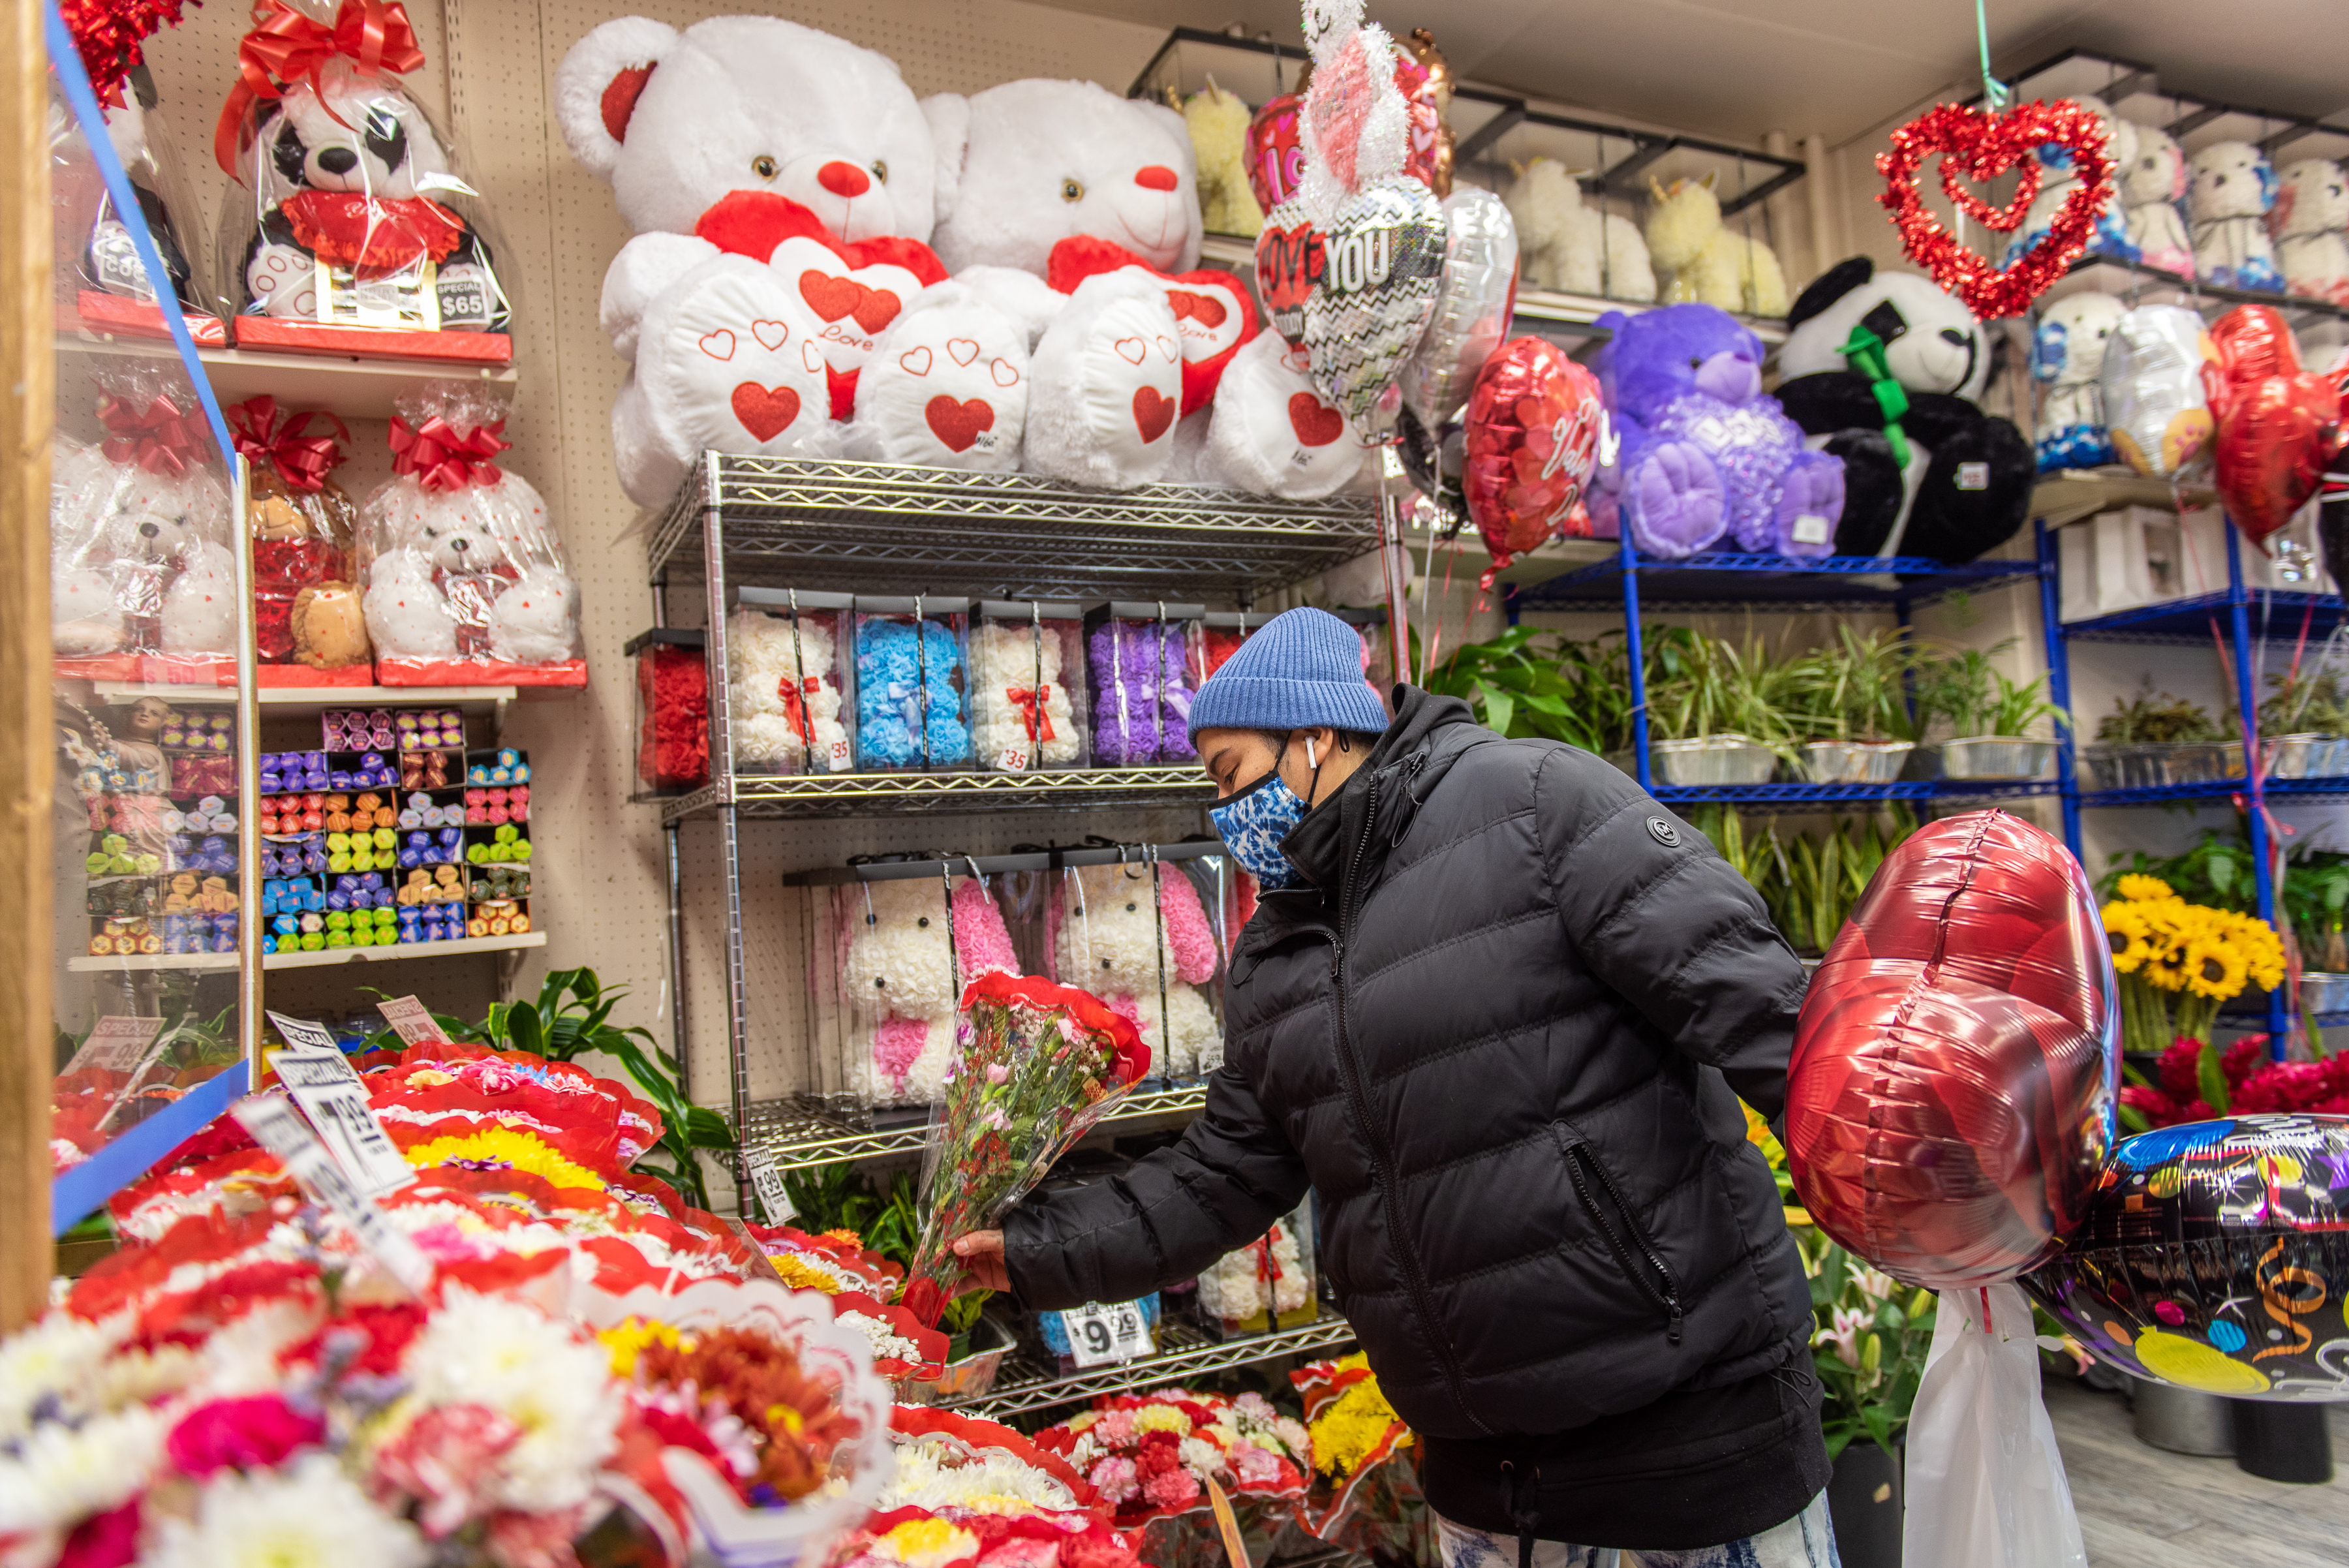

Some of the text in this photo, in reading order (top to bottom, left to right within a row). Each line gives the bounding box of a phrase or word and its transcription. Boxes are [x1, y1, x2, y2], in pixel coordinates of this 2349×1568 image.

[1323, 228, 1390, 293] YOU
[437, 282, 481, 294] SPECIAL
[442, 295, 484, 316] $65
[818, 325, 874, 351] Love
[831, 740, 848, 759] $35
[1656, 823, 1674, 836] MK
[97, 1022, 159, 1036] SPECIAL
[279, 1023, 333, 1046] SPECIAL
[282, 1059, 347, 1085] SPECIAL
[333, 1094, 374, 1133] 99
[746, 1149, 771, 1169] SPECIAL
[763, 1169, 780, 1193] 99
